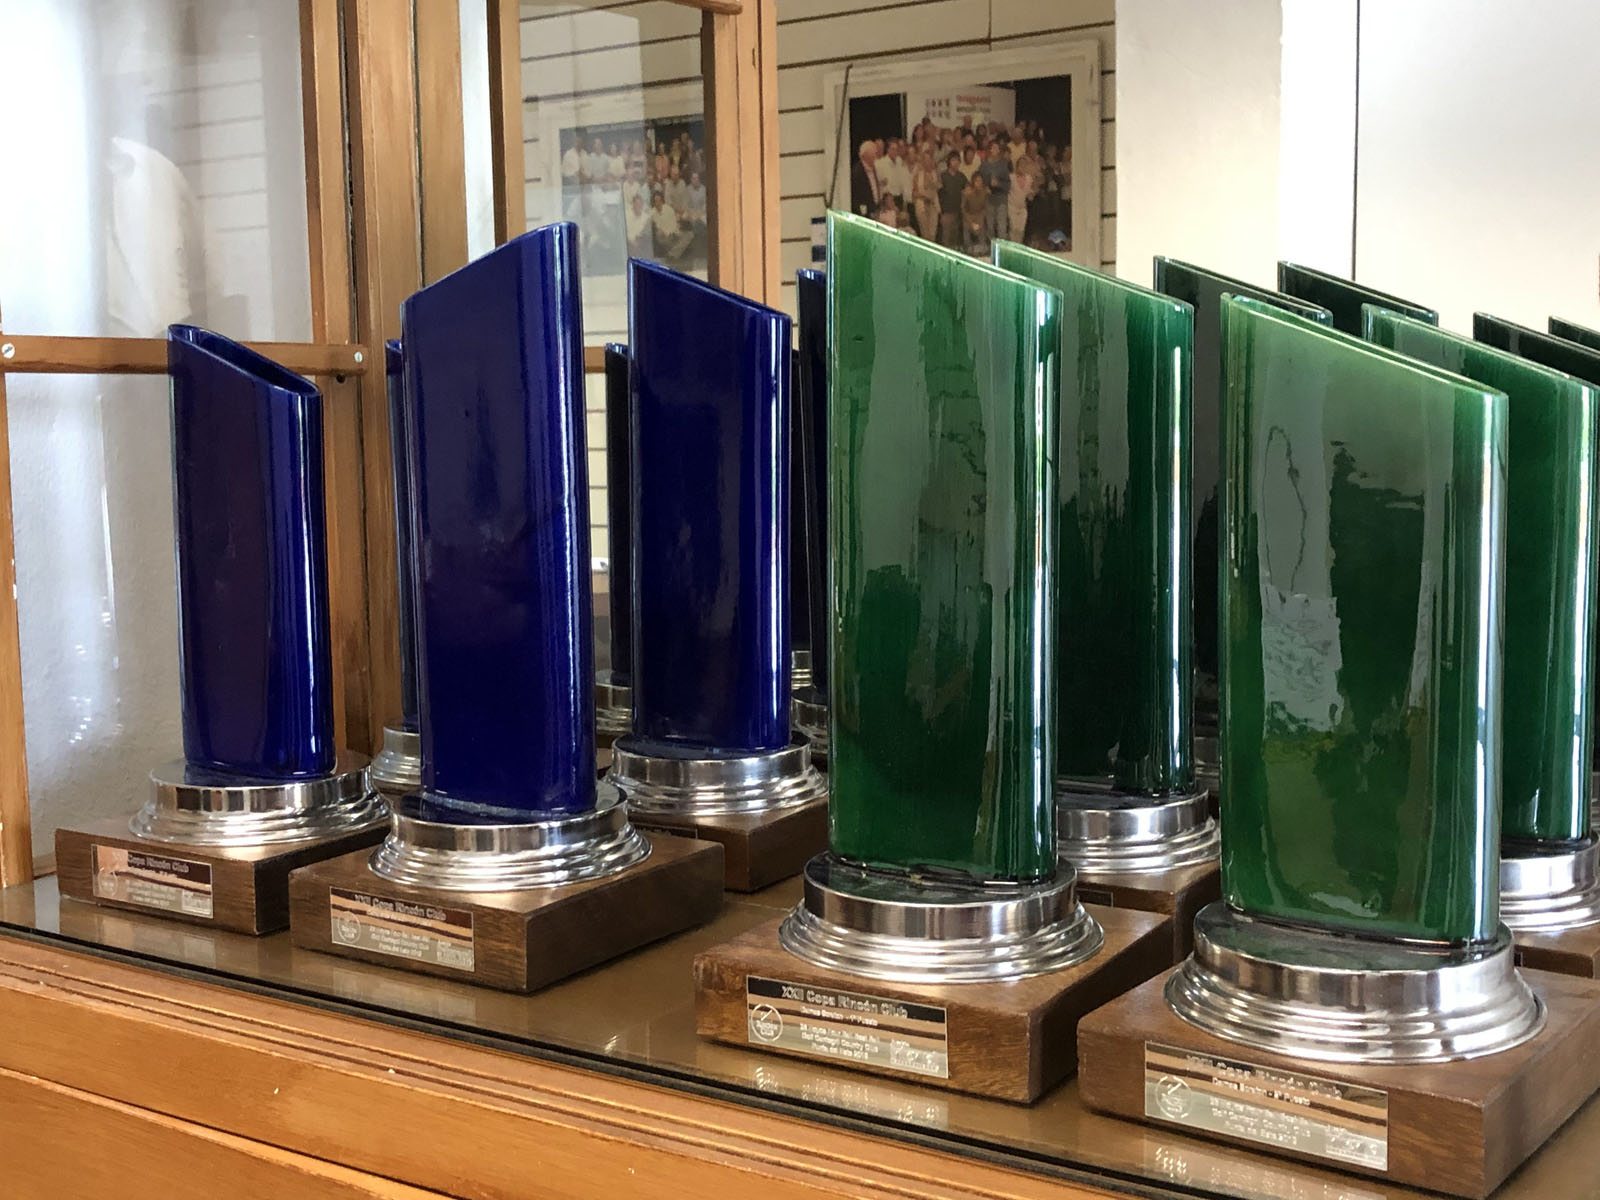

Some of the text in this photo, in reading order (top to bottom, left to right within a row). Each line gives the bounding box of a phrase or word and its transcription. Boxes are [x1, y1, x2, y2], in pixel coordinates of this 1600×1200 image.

[395, 902, 425, 917] Rincón
[426, 908, 447, 921] Club
[806, 990, 836, 1008] Copa
[838, 994, 878, 1014] Rincón
[880, 1002, 908, 1019] Club
